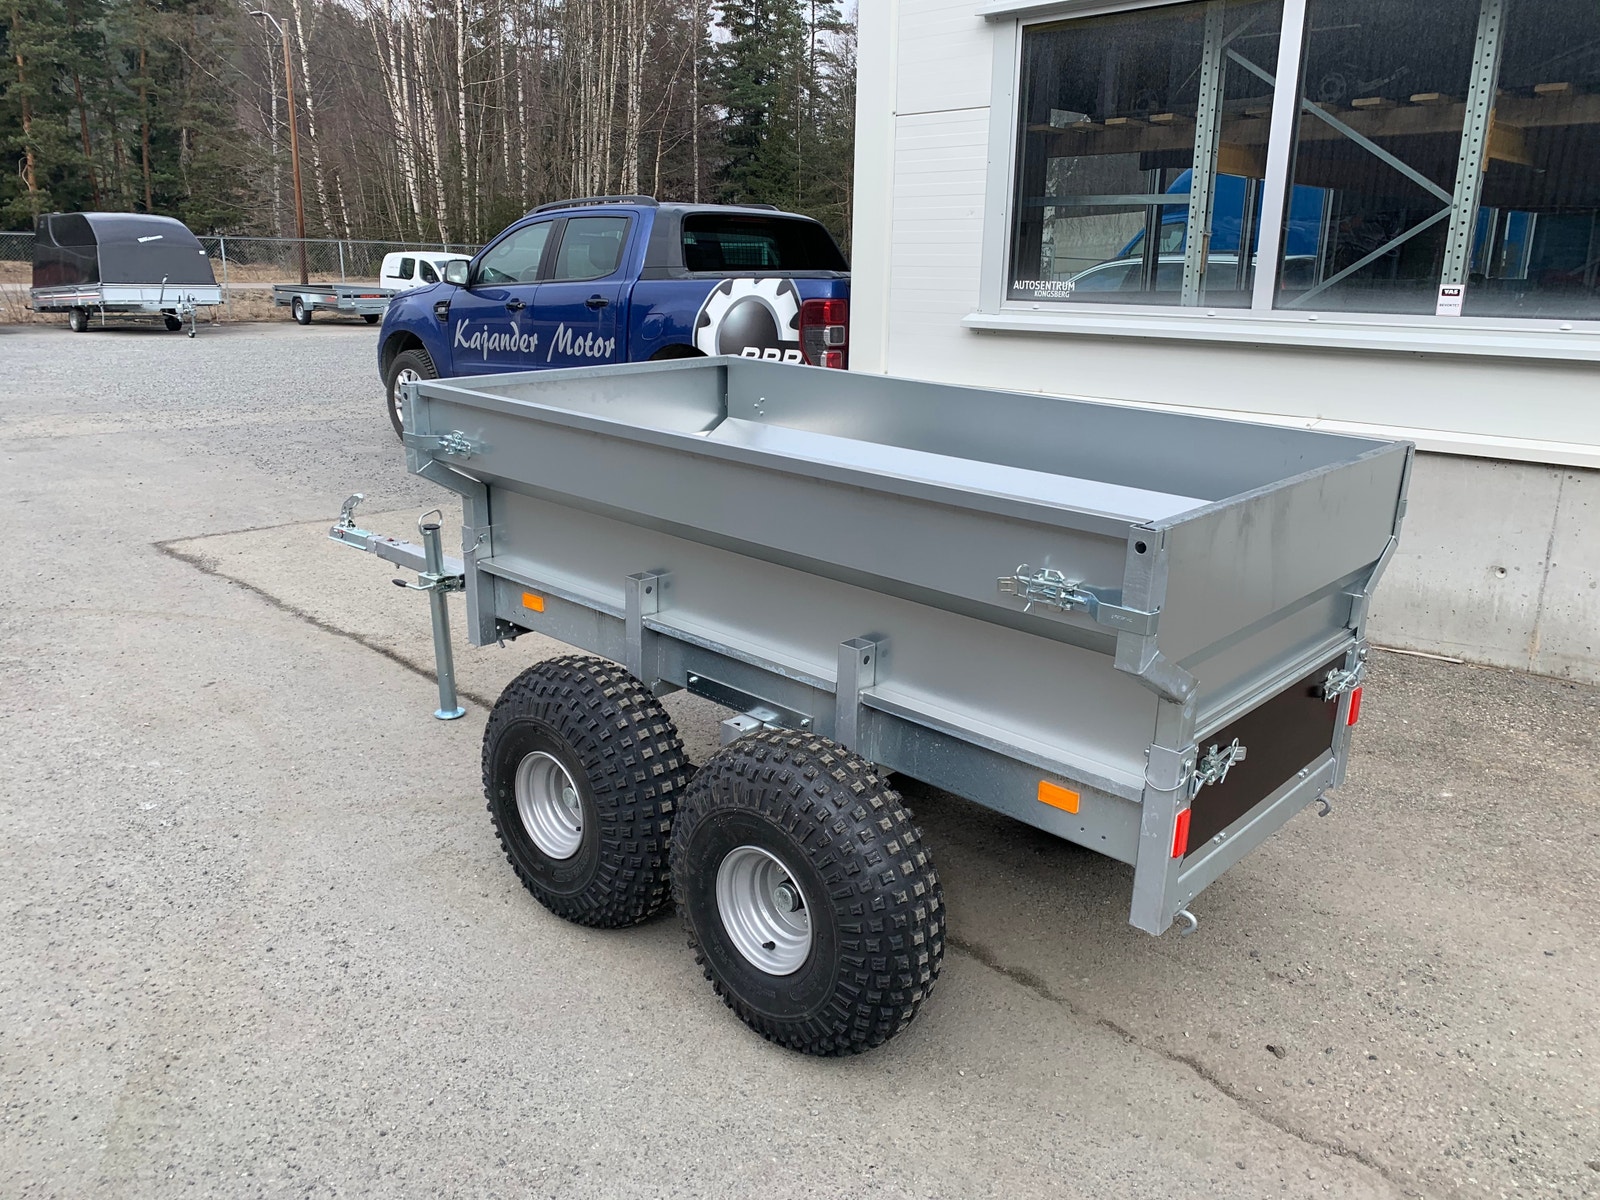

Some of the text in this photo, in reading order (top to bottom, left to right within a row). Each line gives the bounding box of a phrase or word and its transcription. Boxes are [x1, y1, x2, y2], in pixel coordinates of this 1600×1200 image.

[1013, 280, 1075, 291] AUTOSENTRUM
[1034, 290, 1070, 298] KONGSBERG
[454, 318, 615, 362] Kajander Motor
